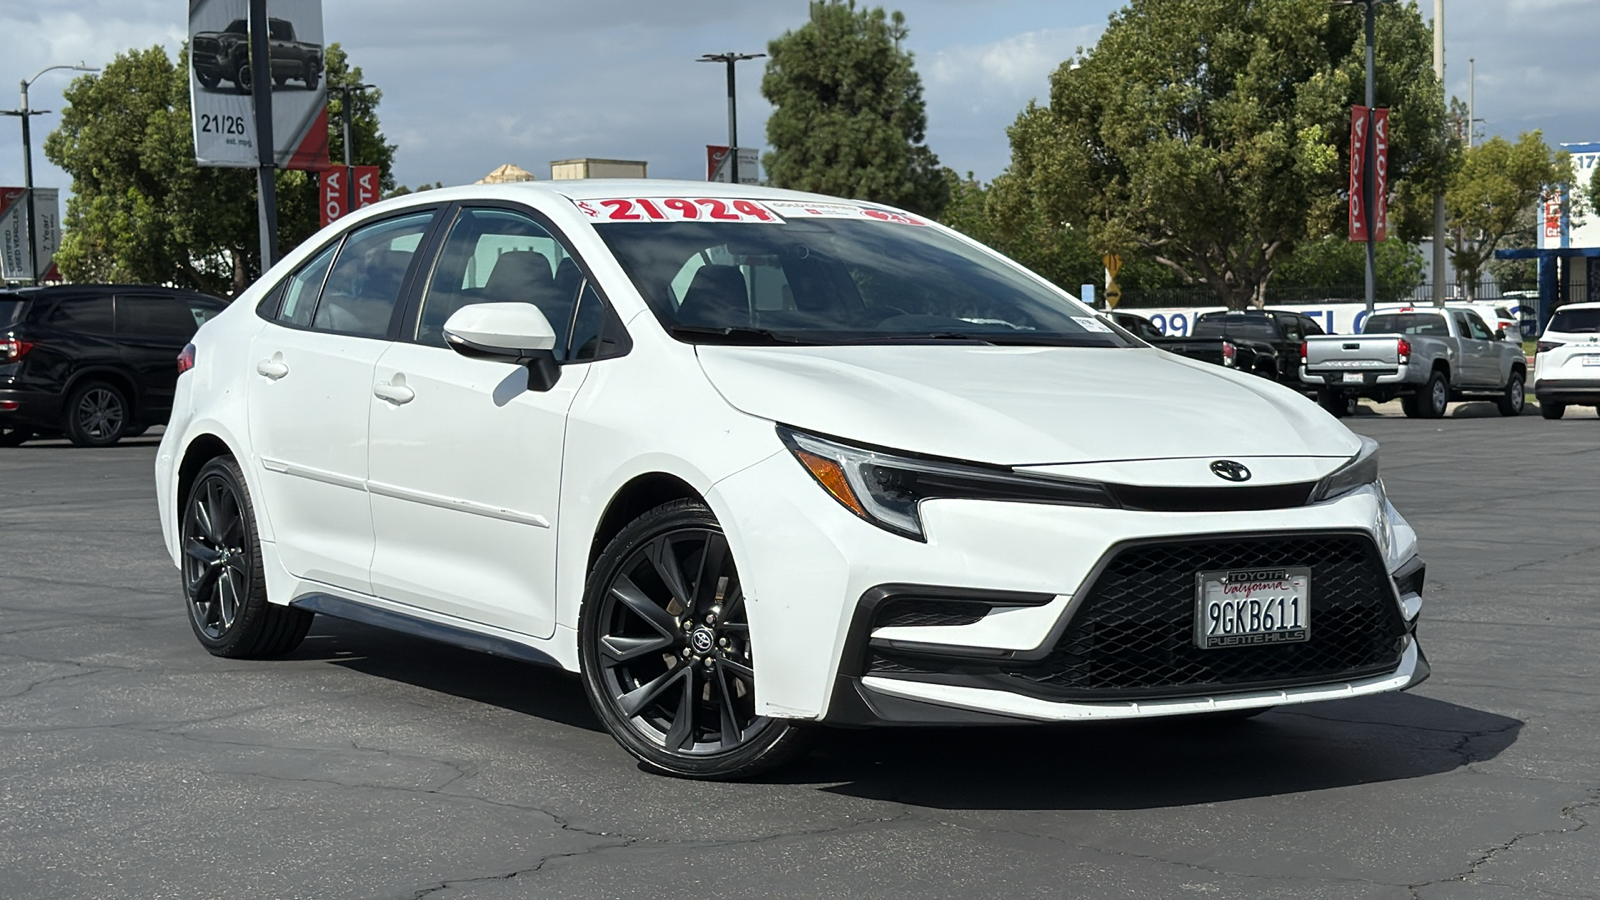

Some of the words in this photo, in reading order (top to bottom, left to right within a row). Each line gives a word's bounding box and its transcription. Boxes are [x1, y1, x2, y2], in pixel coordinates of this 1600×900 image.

[201, 114, 244, 135] 21/26
[1353, 116, 1364, 234] TOYOTA
[1375, 117, 1385, 234] TOYOTA
[12, 208, 20, 248] VEHICLES
[5, 230, 15, 272] CERTIFIED
[14, 249, 23, 272] USED
[1223, 581, 1290, 598] California
[1229, 570, 1285, 582] TOYOTA
[1208, 596, 1302, 635] 9GKB611
[1208, 635, 1263, 646] PUENTE
[1264, 631, 1304, 642] HILLS
